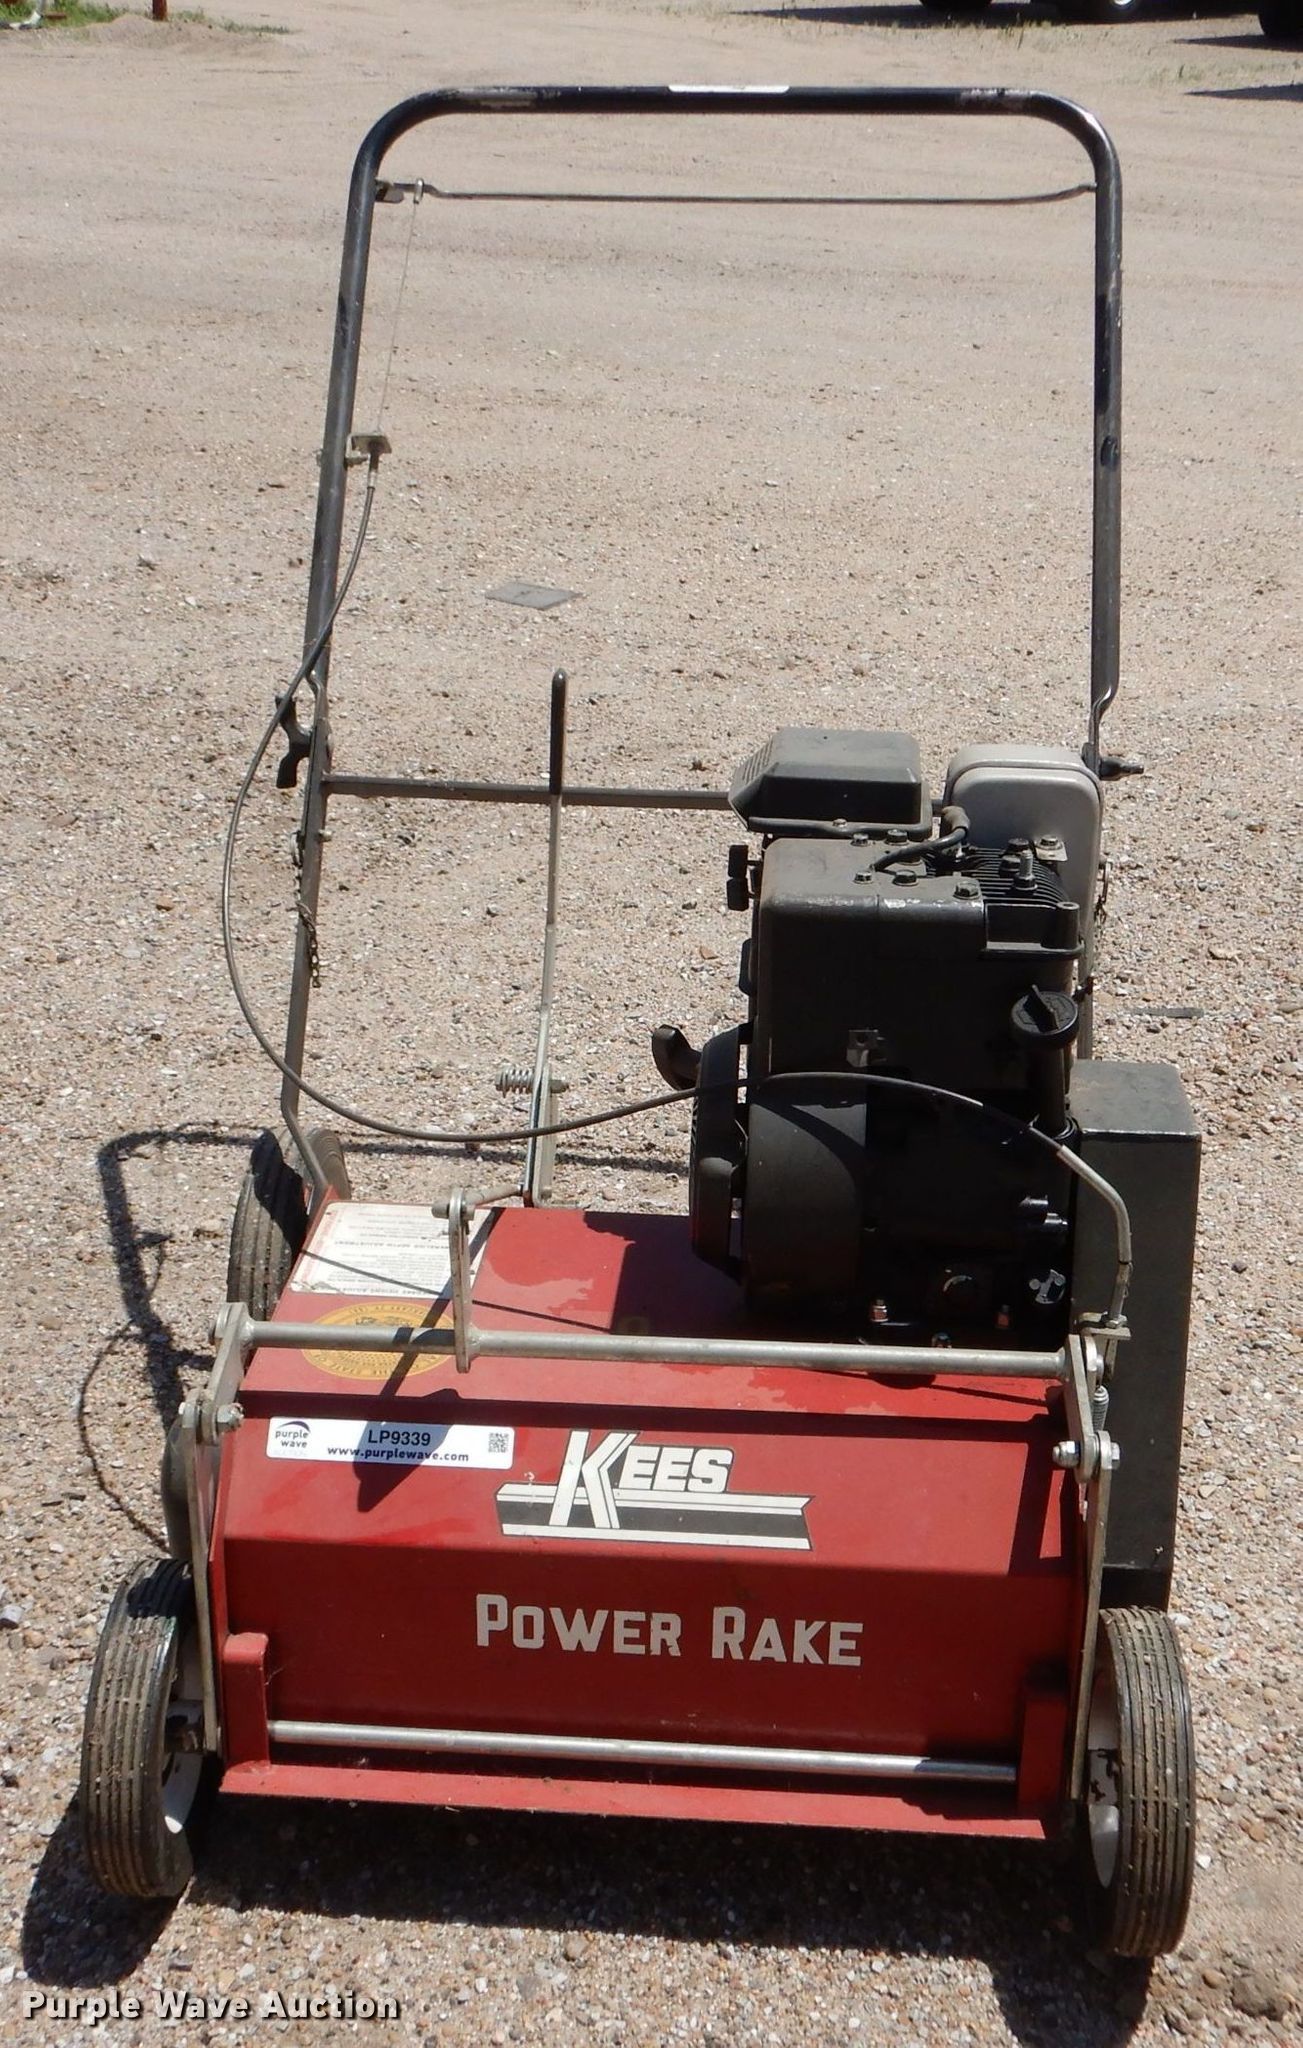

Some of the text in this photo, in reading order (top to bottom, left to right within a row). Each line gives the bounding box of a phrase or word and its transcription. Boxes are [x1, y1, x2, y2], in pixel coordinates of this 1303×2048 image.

[275, 1430, 309, 1439] purple
[367, 1429, 431, 1447] LP9339
[280, 1440, 308, 1448] wave
[327, 1447, 469, 1462] www.purplewave.com
[549, 1430, 735, 1529] KEES
[475, 1593, 864, 1666] POWER RAKE
